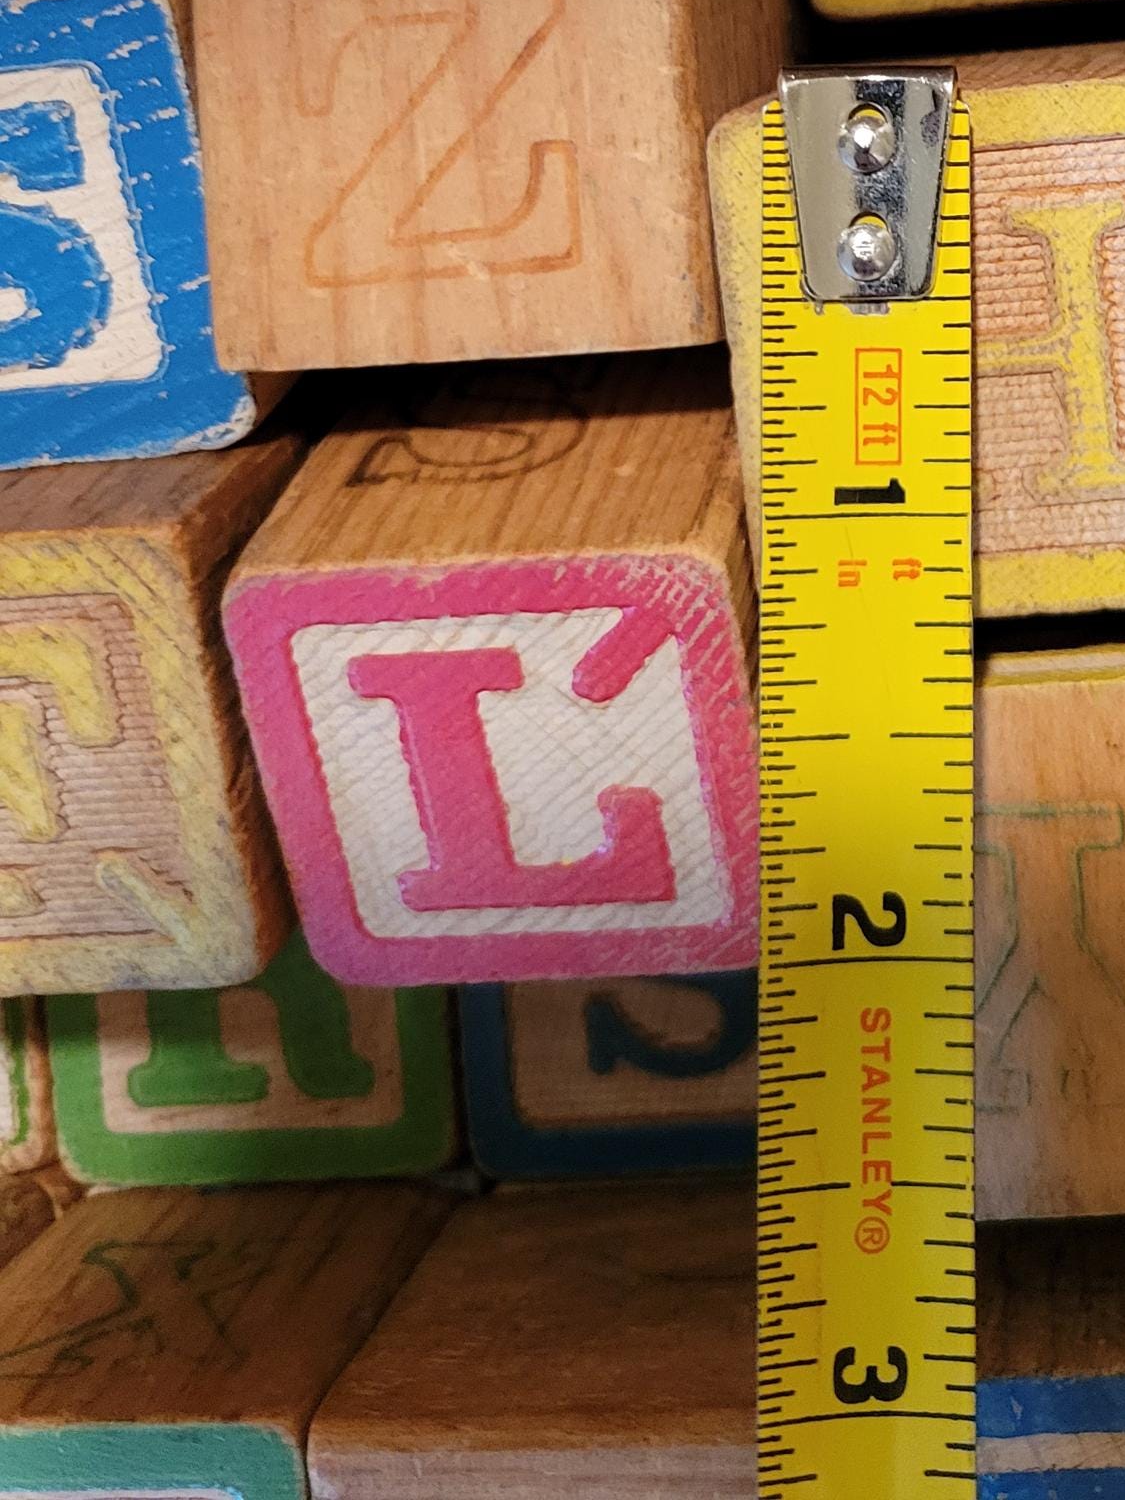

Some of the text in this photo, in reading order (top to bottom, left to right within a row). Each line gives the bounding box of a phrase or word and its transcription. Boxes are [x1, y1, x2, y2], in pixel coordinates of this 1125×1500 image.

[861, 364, 901, 447] 12 ft
[834, 477, 906, 506] 1
[837, 559, 868, 588] in
[892, 557, 922, 581] ft
[832, 890, 907, 952] 2
[833, 1345, 908, 1405] 3
